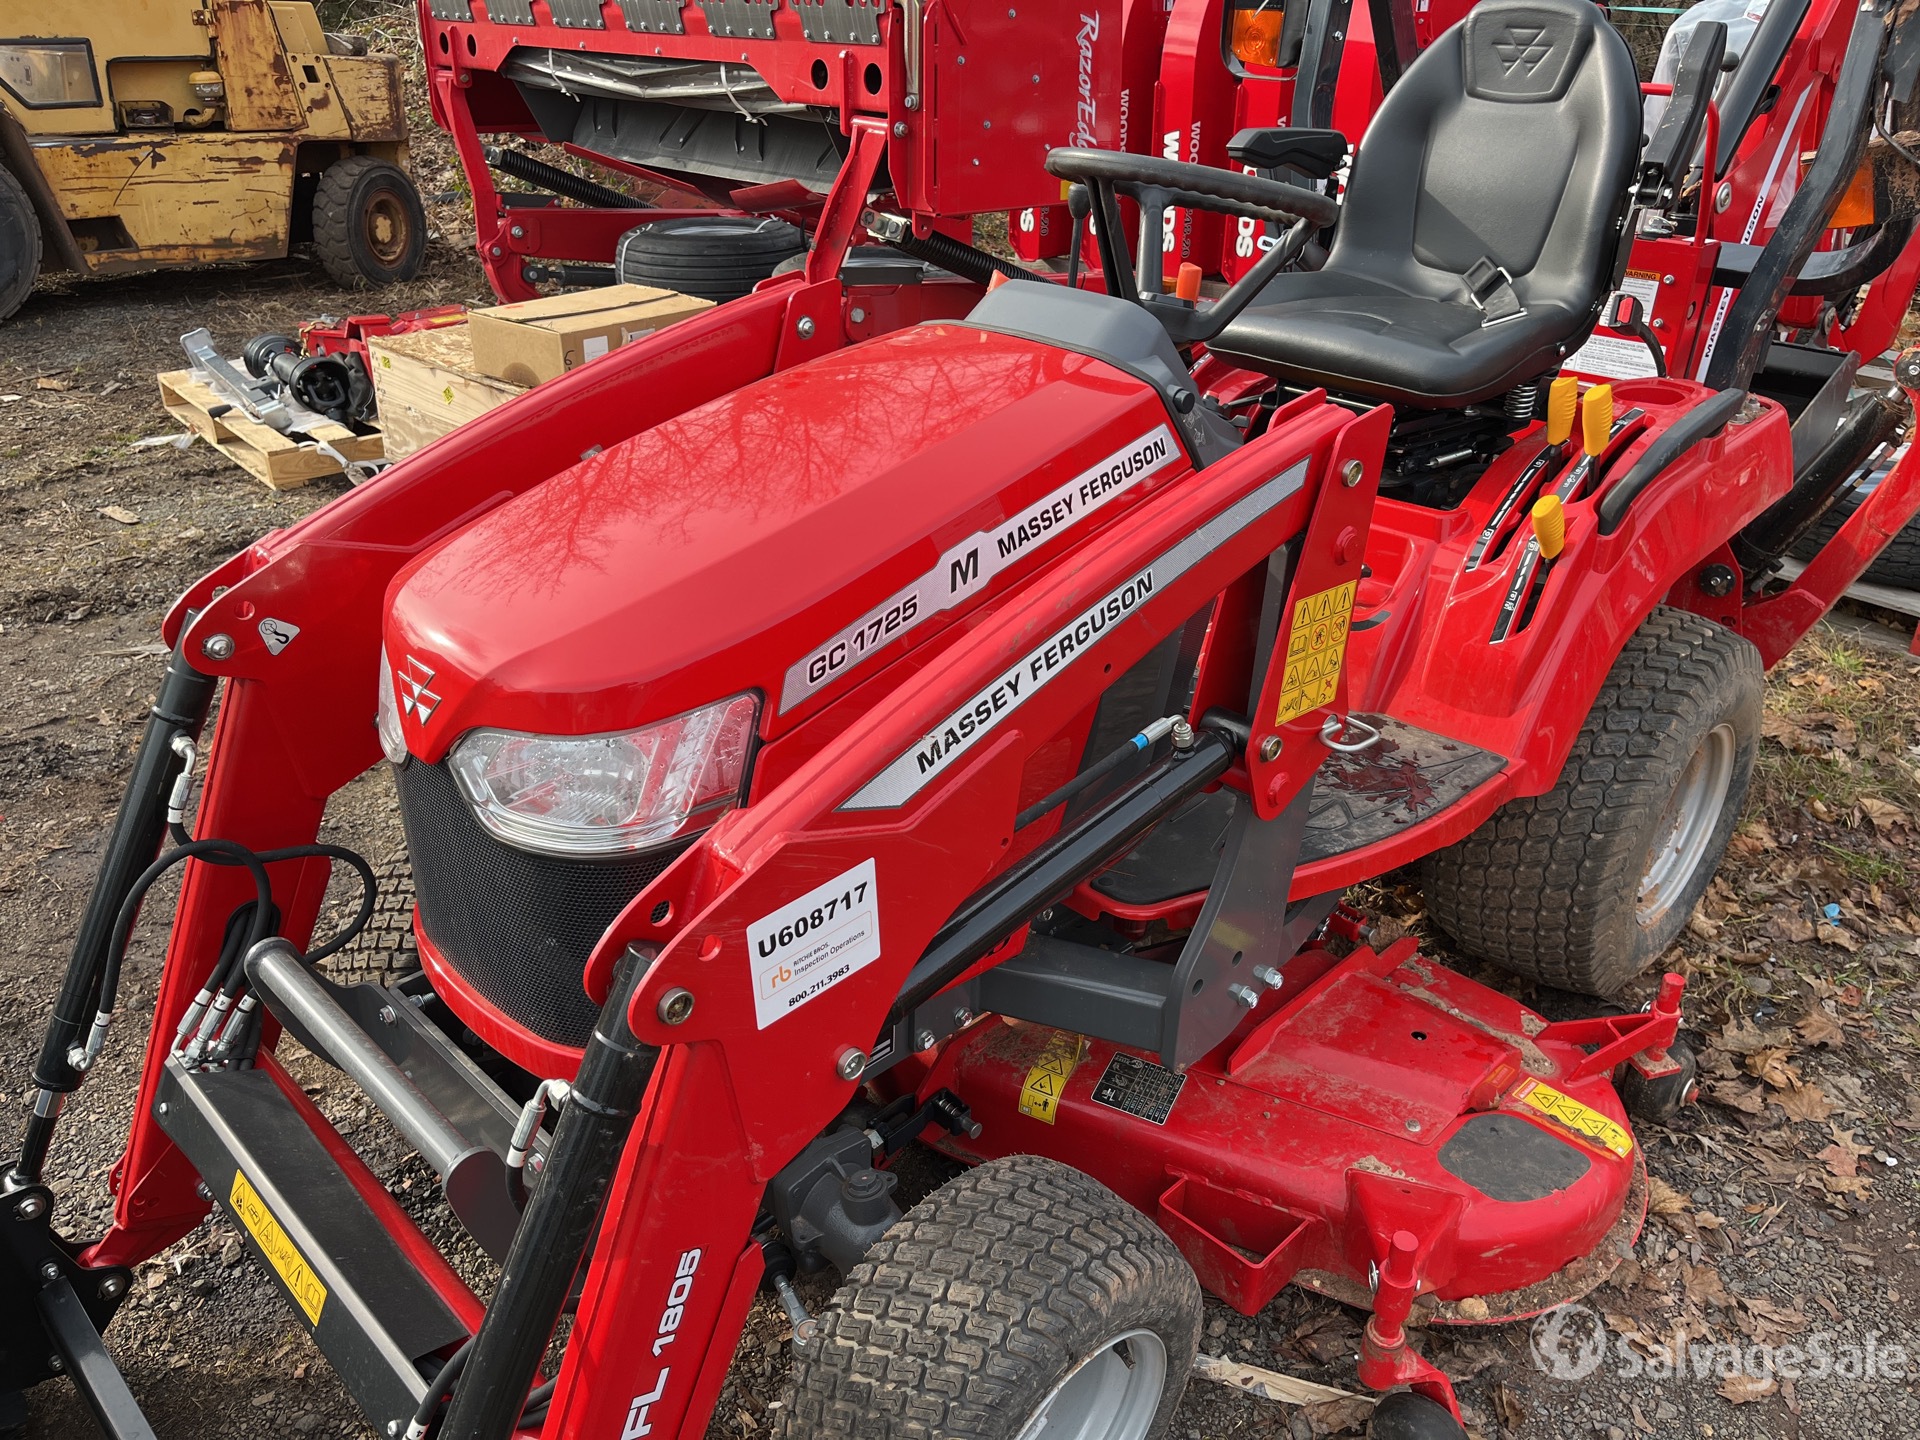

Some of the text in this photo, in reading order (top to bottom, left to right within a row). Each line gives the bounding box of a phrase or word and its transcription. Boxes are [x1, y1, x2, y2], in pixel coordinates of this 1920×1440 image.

[1069, 10, 1099, 149] RazorEdg
[1705, 290, 1730, 358] MASSEY
[997, 438, 1166, 558] MASSEY FERGUSON
[950, 548, 979, 594] M
[809, 595, 918, 684] GC 1725
[916, 571, 1153, 774] MASSEY FERGUSON
[758, 881, 868, 958] U608717
[793, 942, 830, 967] RITCHIE BROS.
[794, 930, 865, 976] Inspection Operations
[771, 965, 792, 989] rb
[788, 964, 851, 1007] 800.211.3983
[621, 1248, 702, 1440] FL 1805
